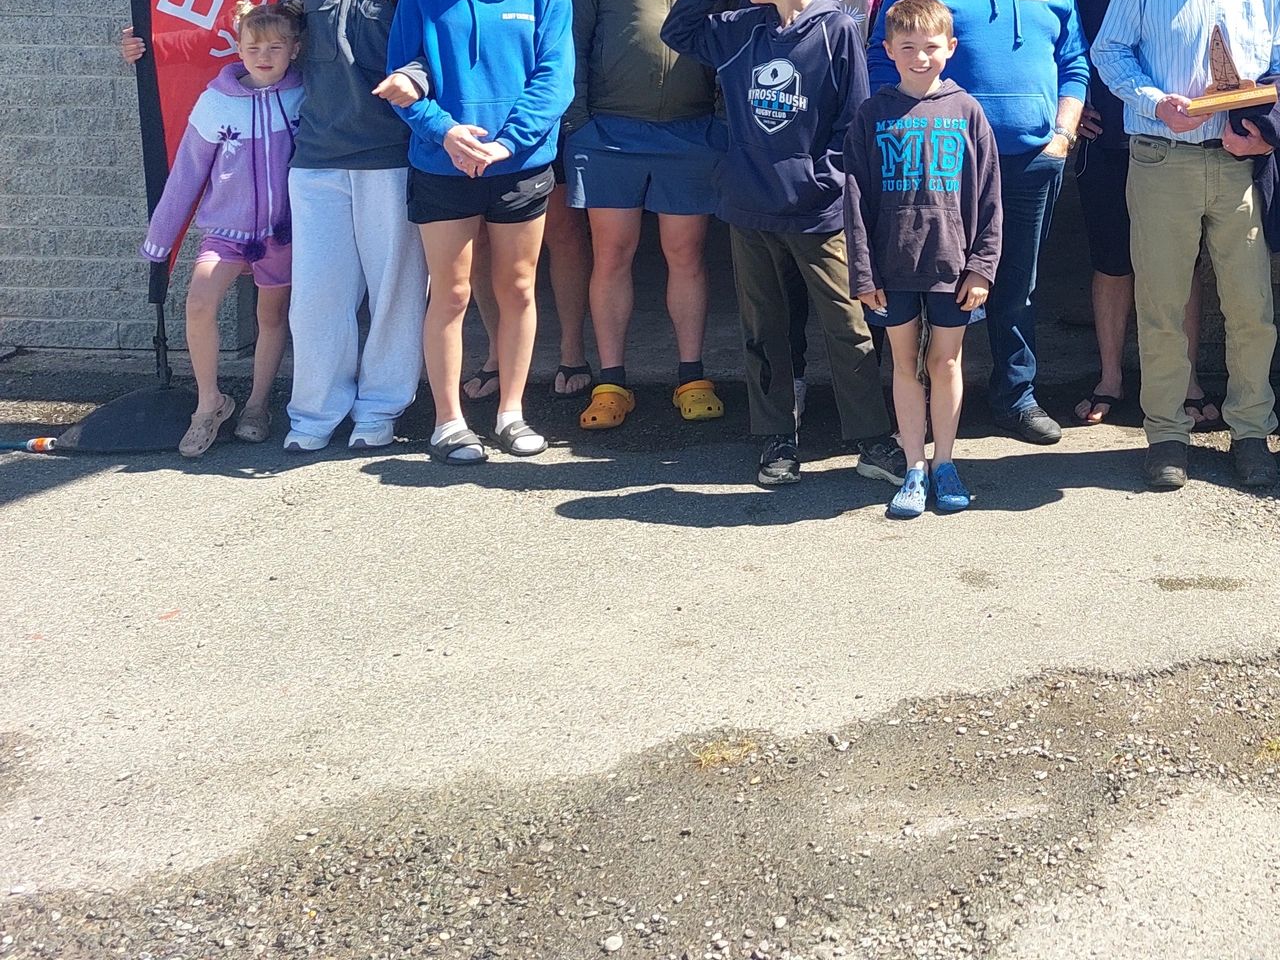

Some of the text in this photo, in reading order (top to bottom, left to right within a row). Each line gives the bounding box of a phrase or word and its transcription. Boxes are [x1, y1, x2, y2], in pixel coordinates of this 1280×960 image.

[779, 92, 807, 109] BUSH
[876, 118, 968, 131] MYROSS BUSH
[876, 130, 966, 177] MB
[928, 178, 960, 192] CLUB
